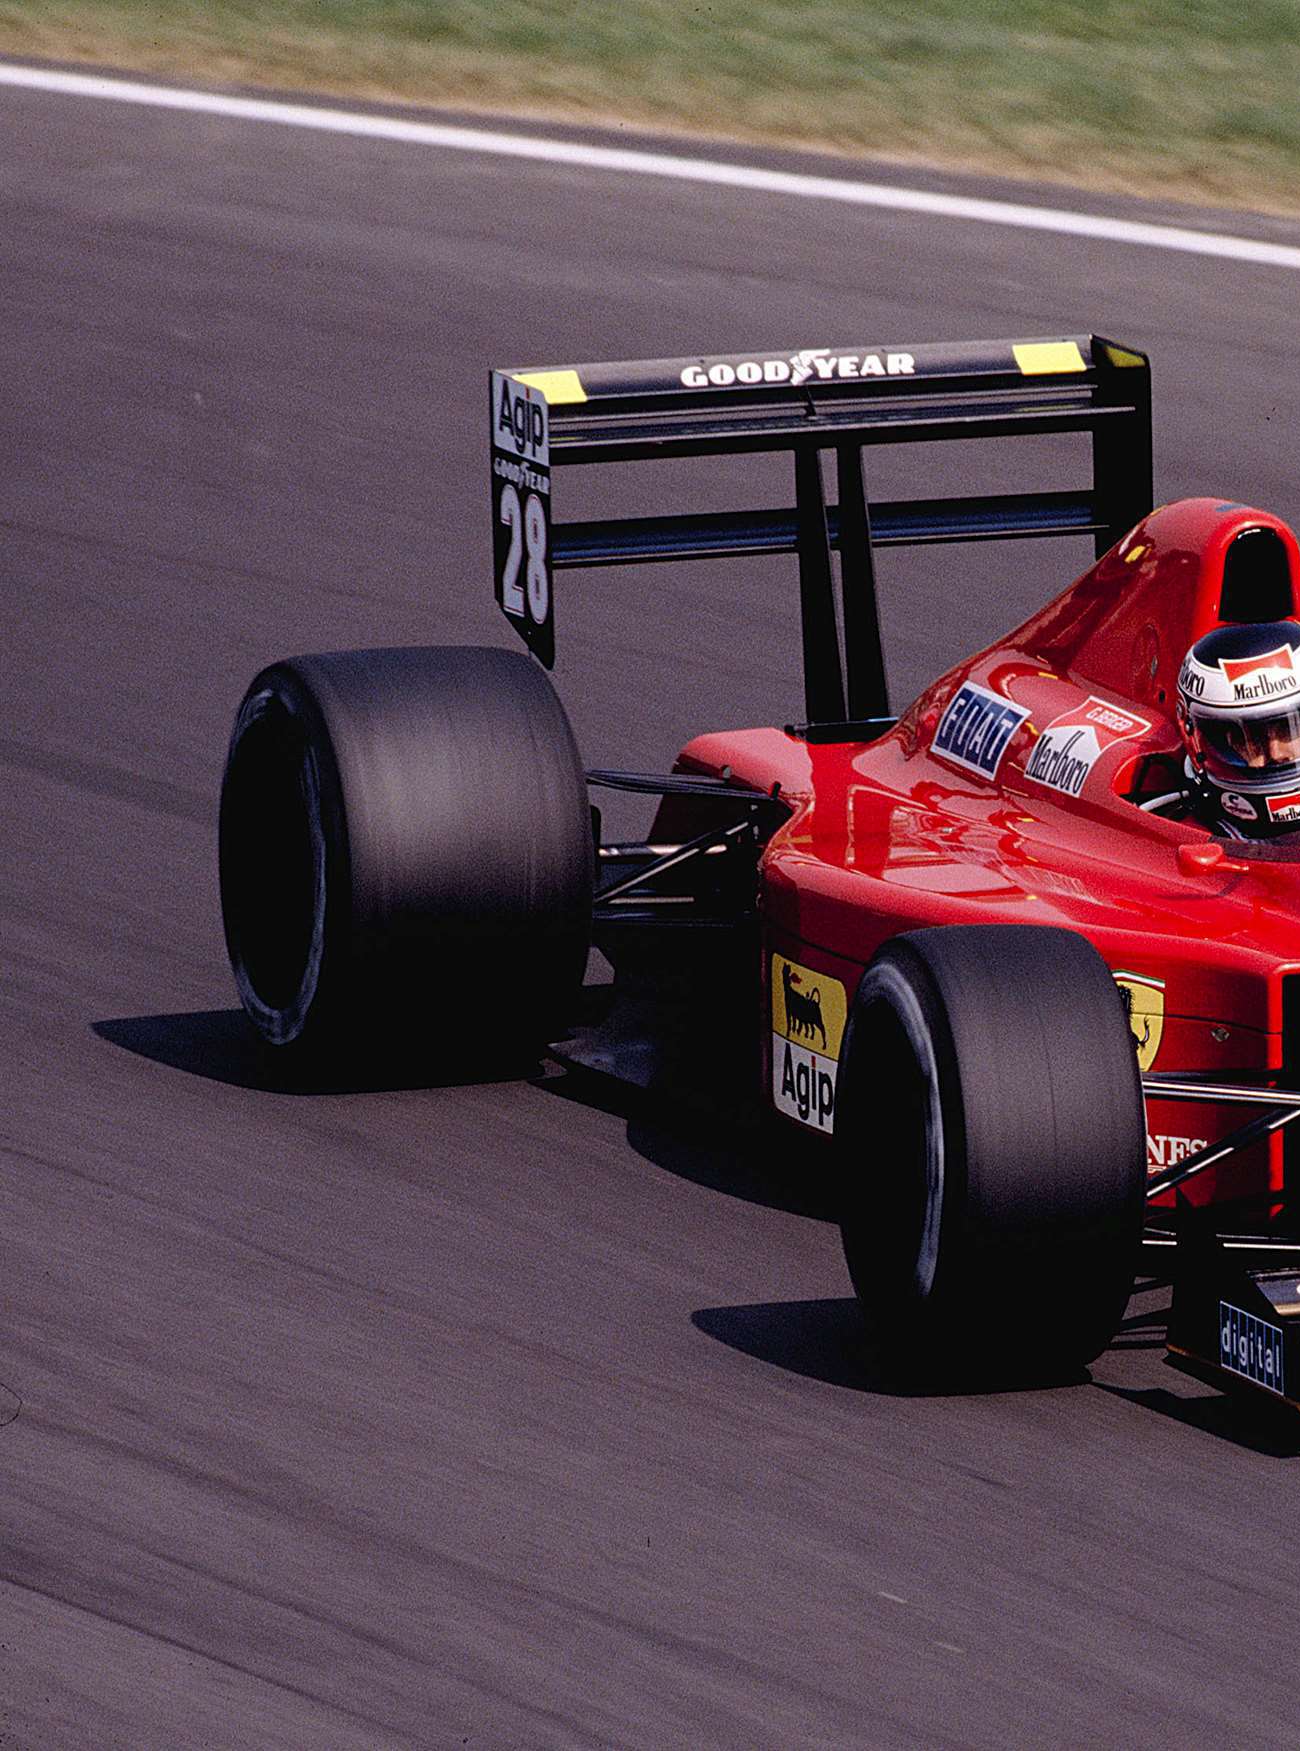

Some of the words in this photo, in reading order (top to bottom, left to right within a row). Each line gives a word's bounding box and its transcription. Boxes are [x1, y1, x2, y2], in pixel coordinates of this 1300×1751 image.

[680, 349, 915, 388] GOODYEAR
[499, 379, 544, 458] Agip
[500, 483, 549, 625] 28
[1233, 674, 1297, 701] Marlboro
[941, 697, 1014, 761] FIAT
[1026, 730, 1090, 794] Marlboro
[781, 1043, 834, 1127] Agip
[1222, 1320, 1281, 1378] digital
